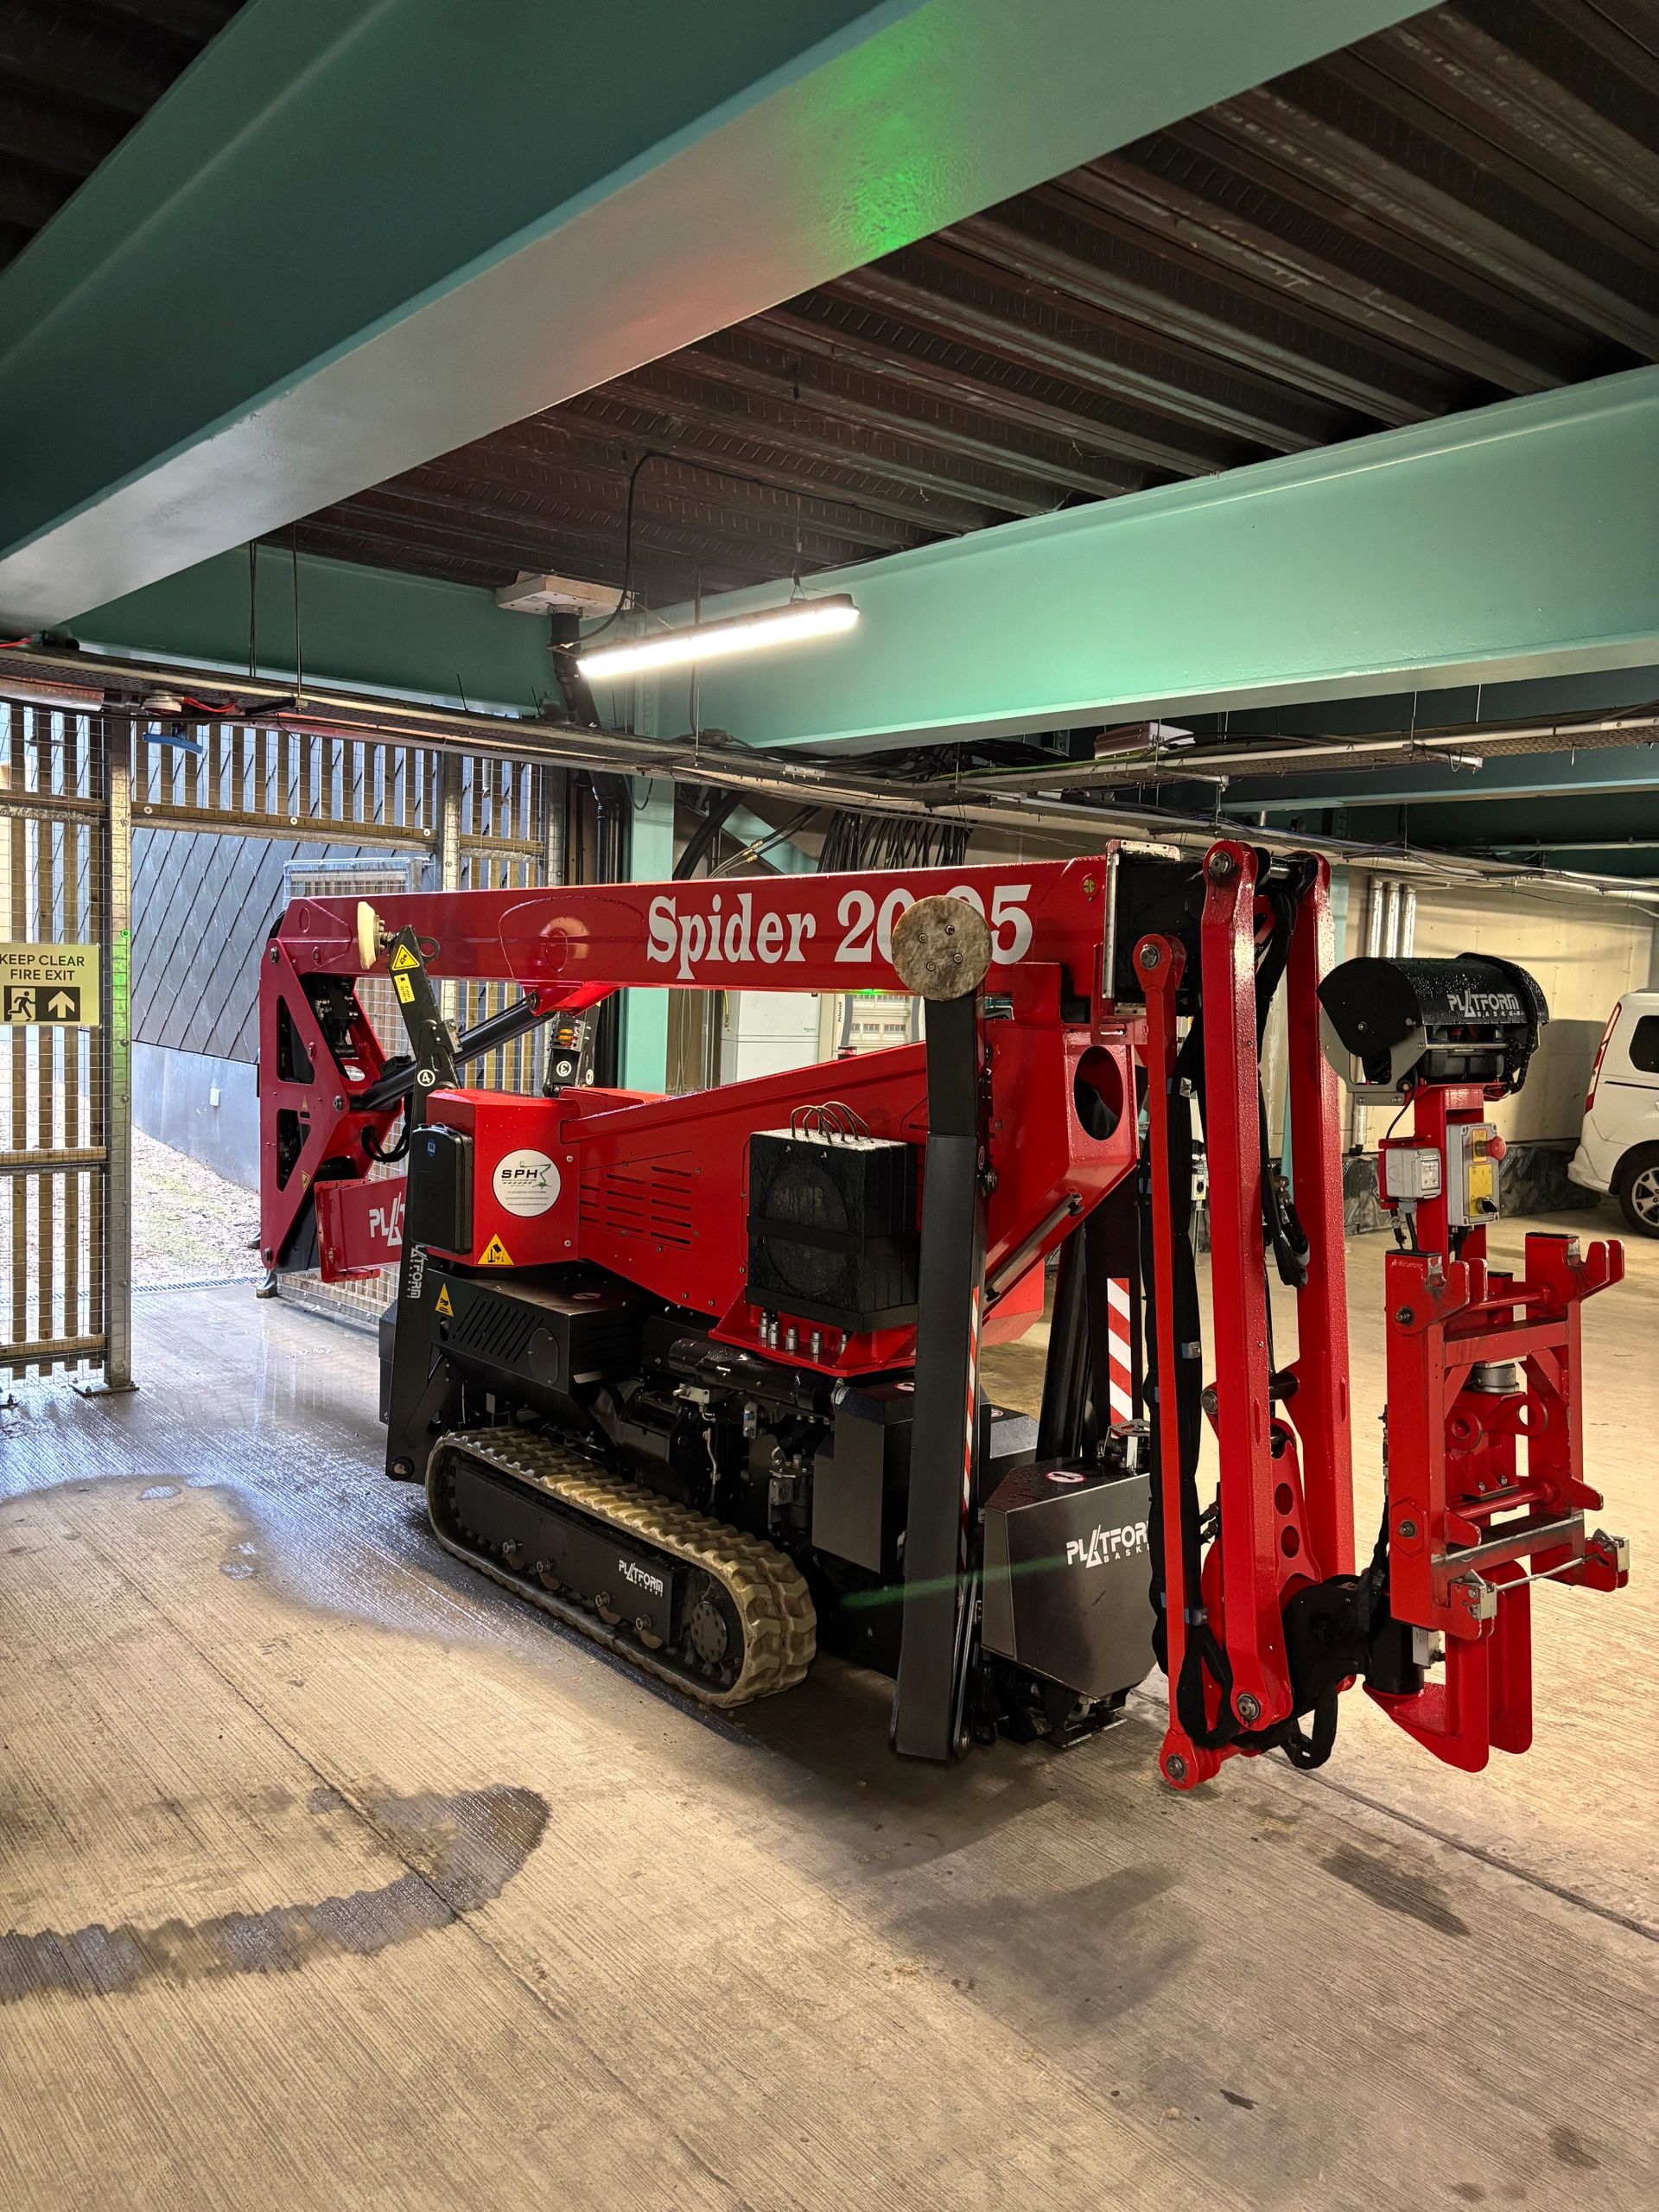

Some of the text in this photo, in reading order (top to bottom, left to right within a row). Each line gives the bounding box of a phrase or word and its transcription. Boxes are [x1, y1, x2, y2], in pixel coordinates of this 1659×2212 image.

[647, 893, 817, 980] Spider
[0, 953, 85, 966] KEEP CLEAR
[10, 969, 75, 981] FIRE EXIT
[1446, 988, 1520, 1018] PLATFORM
[422, 1071, 431, 1084] 4
[501, 1169, 538, 1179] SPH
[1065, 1520, 1149, 1569] PLATFOR
[619, 1559, 664, 1593] PLATFORM
